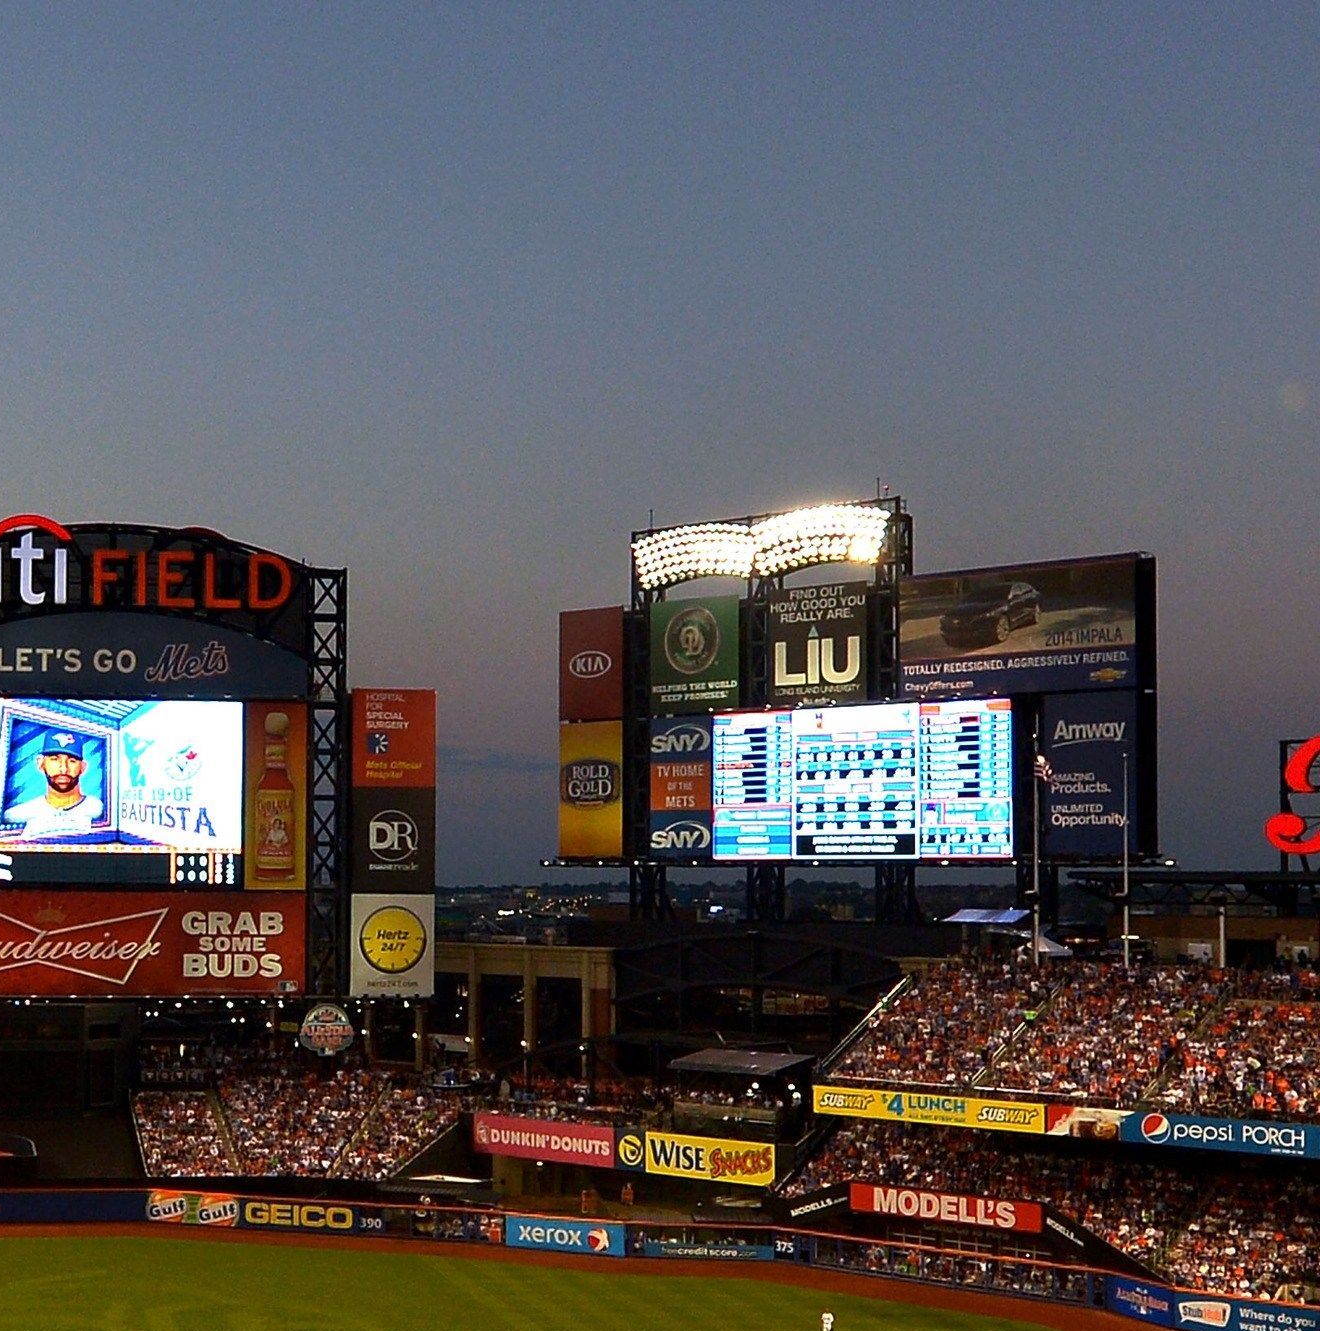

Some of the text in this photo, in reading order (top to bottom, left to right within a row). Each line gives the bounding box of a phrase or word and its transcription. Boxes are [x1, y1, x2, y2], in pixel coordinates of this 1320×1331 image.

[91, 549, 292, 609] FIELD
[789, 586, 844, 599] FIND OUT
[770, 595, 866, 613] HOW GOOD YOU
[780, 608, 854, 623] REALLY ARE.
[1045, 628, 1123, 646] 2014 IMPALA
[93, 649, 137, 673] GO
[144, 640, 230, 682] Mets
[576, 660, 604, 673] KIA
[775, 635, 860, 686] LIU
[904, 651, 1130, 676] TOTALLY REDESIGNED. AGGRESSIVELY REFINED.
[689, 682, 706, 690] THE
[708, 680, 738, 689] WORLD
[905, 679, 974, 693] ChevyOffers.com
[366, 702, 383, 710] FOR
[366, 711, 404, 720] SPECIAL
[1054, 720, 1126, 742] Amway
[651, 730, 705, 753] SNY
[573, 765, 609, 779] ROLD
[657, 764, 705, 777] TV HOME
[569, 780, 612, 797] GOLD
[1051, 782, 1111, 794] Products.
[666, 796, 696, 808] METS
[1051, 803, 1103, 813] UNLIMITED
[121, 802, 217, 837] BAUTISTA
[1051, 813, 1129, 828] Opportunity.
[370, 822, 418, 851] DR
[650, 828, 705, 850] SNY
[182, 911, 284, 936] GRAB
[199, 937, 267, 952] SOME
[376, 930, 409, 941] Hertz
[381, 942, 405, 952] 24/7
[182, 953, 284, 978] BUDS
[820, 1093, 875, 1110] SUBWAY
[882, 1093, 904, 1117] $4
[908, 1095, 966, 1114] LUNCH
[979, 1105, 1040, 1124] SUBWAY
[490, 1129, 610, 1156] DUNKIN' DONUTS
[1174, 1123, 1305, 1148] pepsi PORCH
[651, 1139, 772, 1179] WISE SNACKS
[149, 1198, 236, 1221] Gulf Gulf
[245, 1202, 354, 1229] GEICO
[873, 1187, 1016, 1229] MODELL'S
[360, 1217, 382, 1229] 390
[519, 1225, 581, 1246] xerox
[775, 1241, 794, 1253] 375
[1239, 1308, 1315, 1328] Where do you
